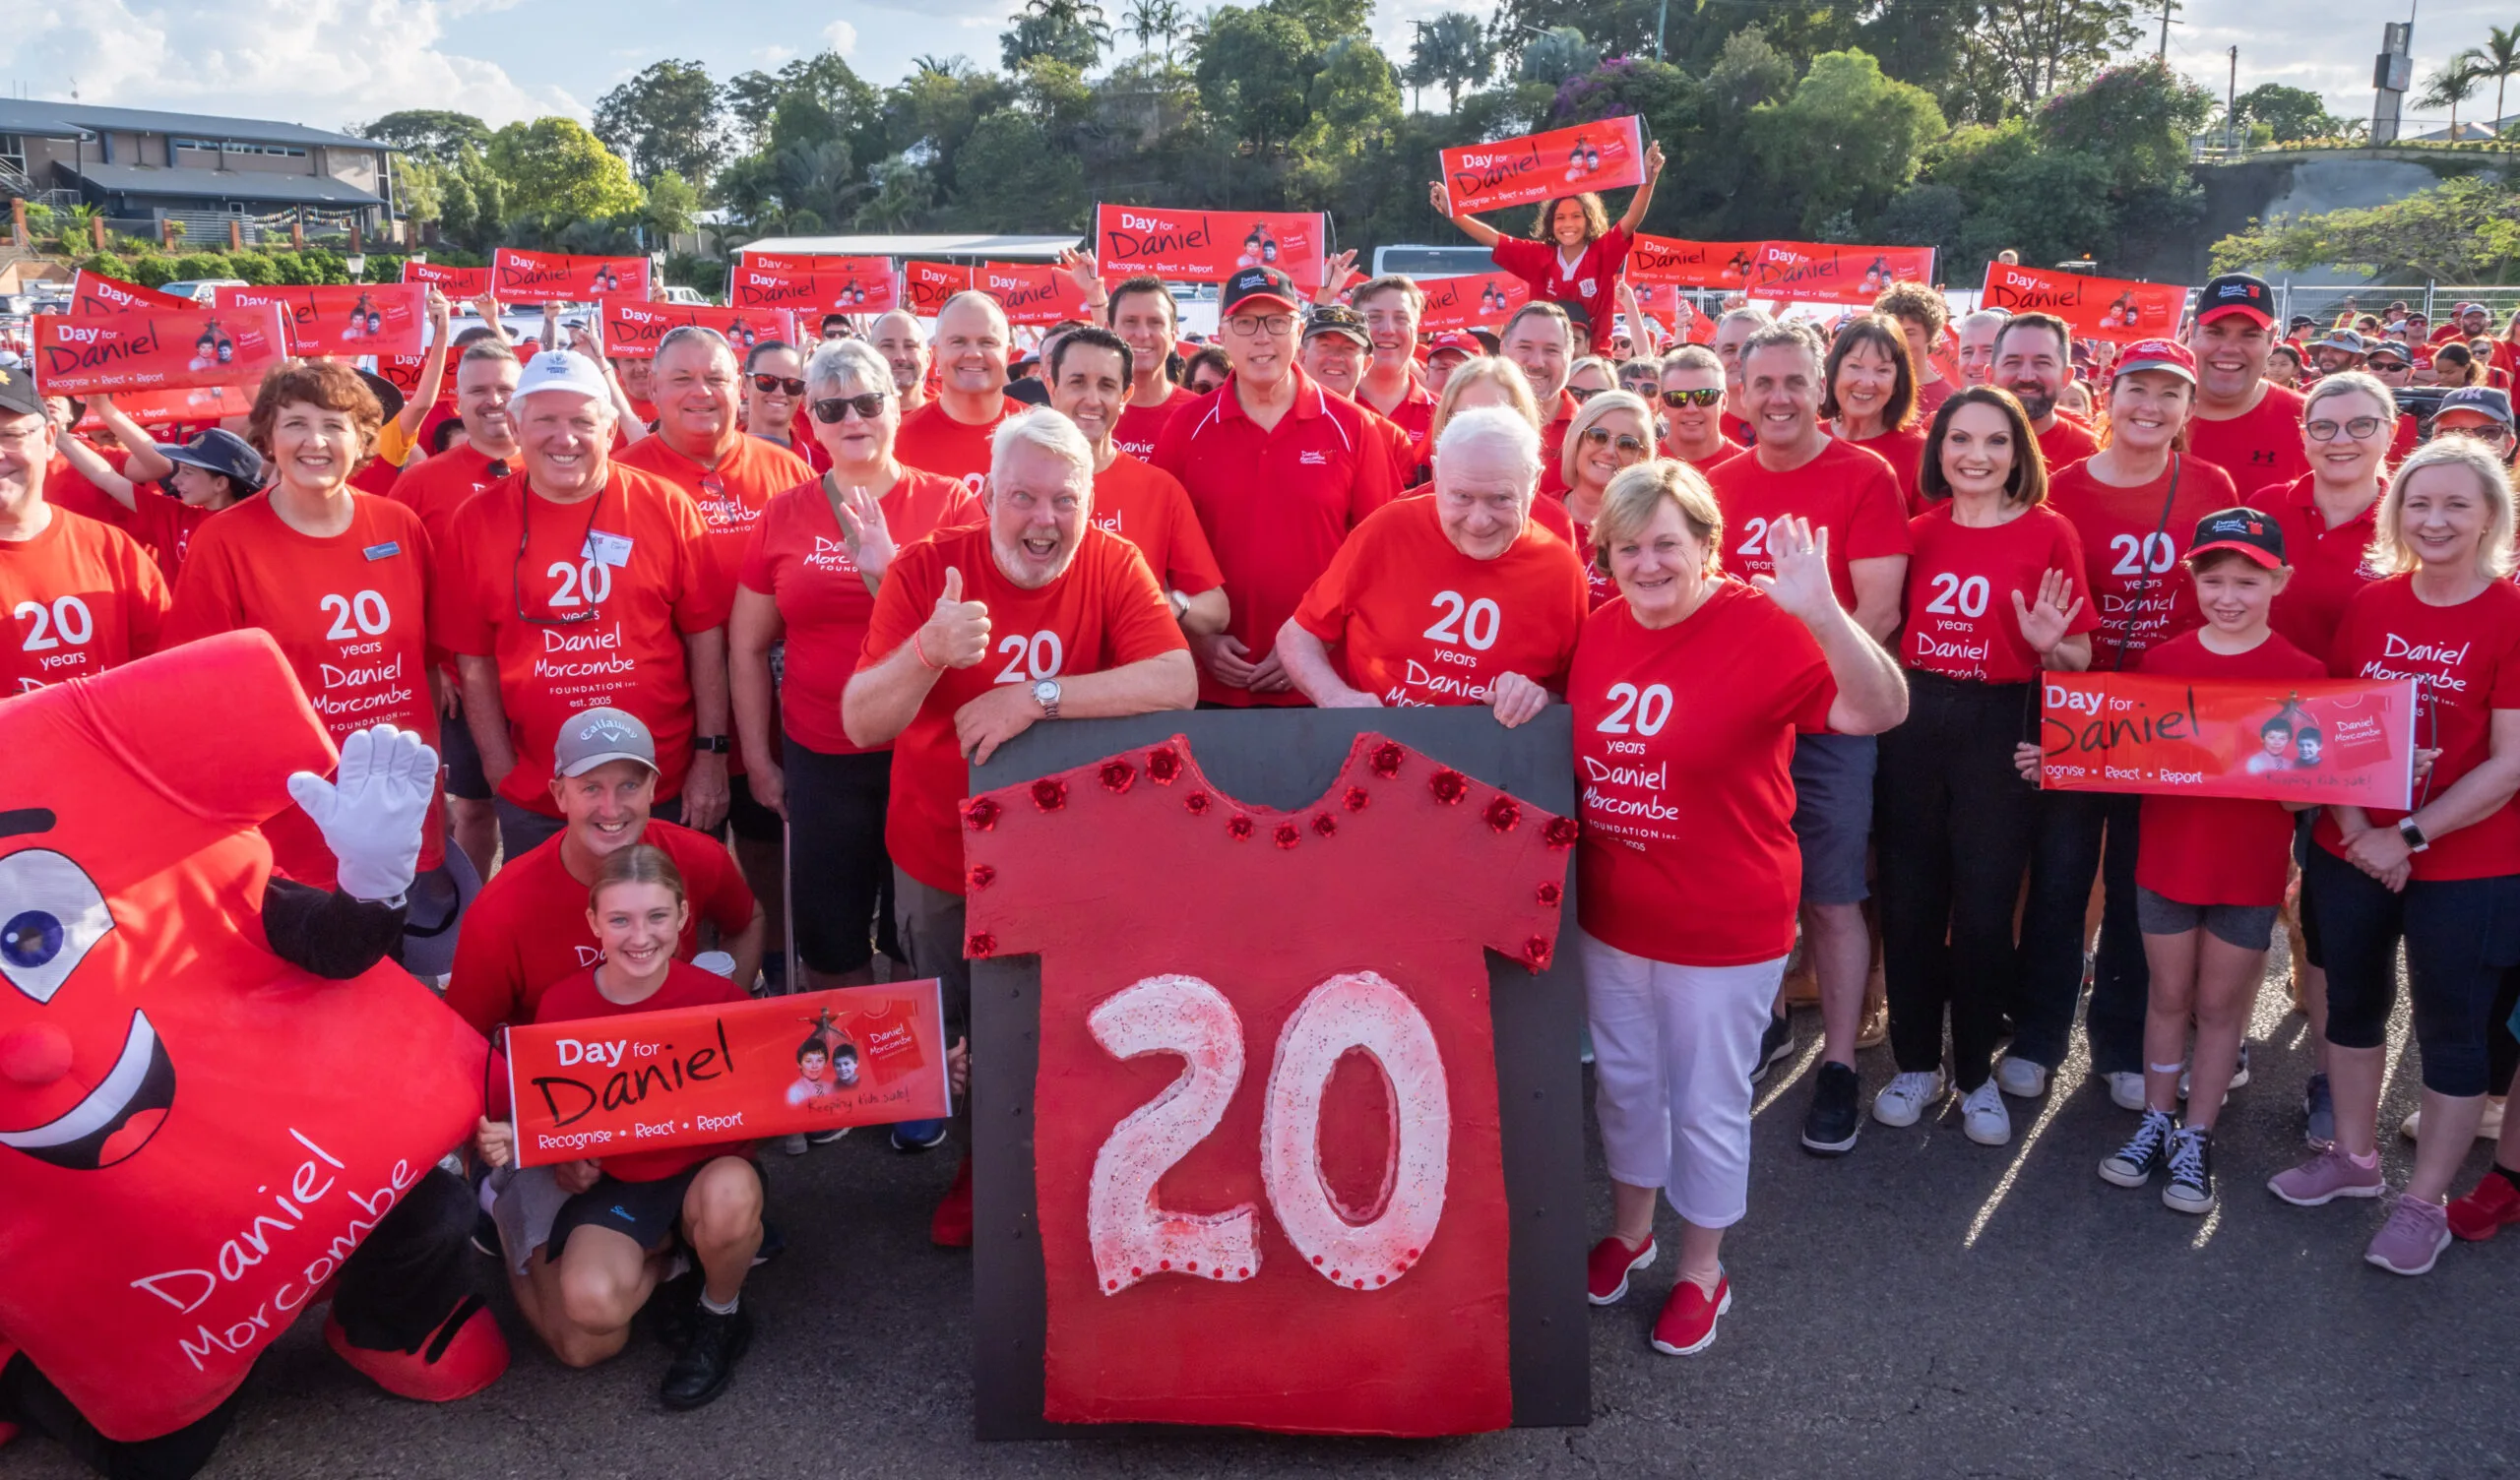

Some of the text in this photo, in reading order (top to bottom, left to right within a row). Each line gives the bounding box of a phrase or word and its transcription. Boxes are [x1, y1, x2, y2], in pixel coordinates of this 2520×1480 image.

[1453, 141, 1542, 197] Daniel
[1462, 152, 1508, 168] Day for
[1121, 214, 1173, 233] Day for
[1107, 216, 1211, 259] Daniel
[1644, 241, 1670, 254] Day
[510, 255, 536, 271] Day
[1107, 261, 1213, 274] Recognise React Report
[1634, 247, 1706, 271] Daniel
[1758, 250, 1839, 285] Daniel
[1768, 248, 1797, 264] Day
[418, 268, 441, 279] Day
[500, 259, 573, 287] Daniel
[750, 274, 777, 287] Day
[921, 269, 948, 284] Day
[988, 276, 1018, 290] Day
[2006, 272, 2050, 289] Day for
[98, 282, 133, 306] Day
[235, 294, 268, 307] Day
[740, 276, 816, 305] Daniel
[1424, 281, 1459, 312] niel
[1993, 278, 2082, 309] Daniel
[621, 307, 652, 324] Day
[57, 325, 117, 344] Day for
[43, 319, 159, 375] Daniel
[384, 350, 461, 387] Dael
[395, 353, 424, 366] Day
[46, 372, 165, 390] Recognise React Report
[698, 493, 742, 512] aniel
[2110, 531, 2175, 576] 20
[547, 560, 611, 607] 20
[1925, 572, 1990, 618] 20
[2103, 589, 2177, 612] Daniel
[14, 595, 94, 651] 20
[320, 589, 391, 640] 20
[1422, 590, 1500, 650] 20
[1936, 619, 1974, 633] years
[542, 621, 621, 652] Daniel
[1917, 631, 1989, 660] Daniel
[39, 651, 87, 671] years
[340, 641, 383, 658] years
[993, 630, 1063, 684] 20
[1433, 648, 1478, 668] years
[2383, 633, 2470, 665] Daniel
[320, 652, 401, 688] Daniel
[535, 652, 635, 678] Morcombe
[549, 681, 623, 695] FOUNDATION
[1406, 658, 1495, 700] Daniel
[312, 683, 412, 714] Morcombe
[589, 696, 611, 706] 2005
[1596, 682, 1673, 736] 20
[2046, 685, 2133, 715] Day for
[330, 712, 399, 731] FOUNDATION
[580, 718, 648, 741] Callaway
[2044, 686, 2199, 757] Daniel
[2336, 715, 2374, 732] Daniel
[2334, 727, 2383, 743] Morcombe
[1606, 740, 1646, 755] years
[1583, 756, 1666, 790] Daniel
[2106, 766, 2141, 780] React
[2160, 769, 2203, 785] Report
[1583, 785, 1678, 820] Morcombe
[1589, 819, 1659, 839] FOUNDATION
[869, 1023, 905, 1045] Daniel
[869, 1034, 914, 1057] Morcombe
[556, 1037, 661, 1068] Day for
[531, 1018, 734, 1128] Daniel
[807, 1095, 853, 1115] Keeping
[538, 1112, 744, 1150] Recognise React Report
[1087, 971, 1452, 1296] 20
[130, 1127, 346, 1315] Daniel
[179, 1159, 418, 1372] Morcombe
